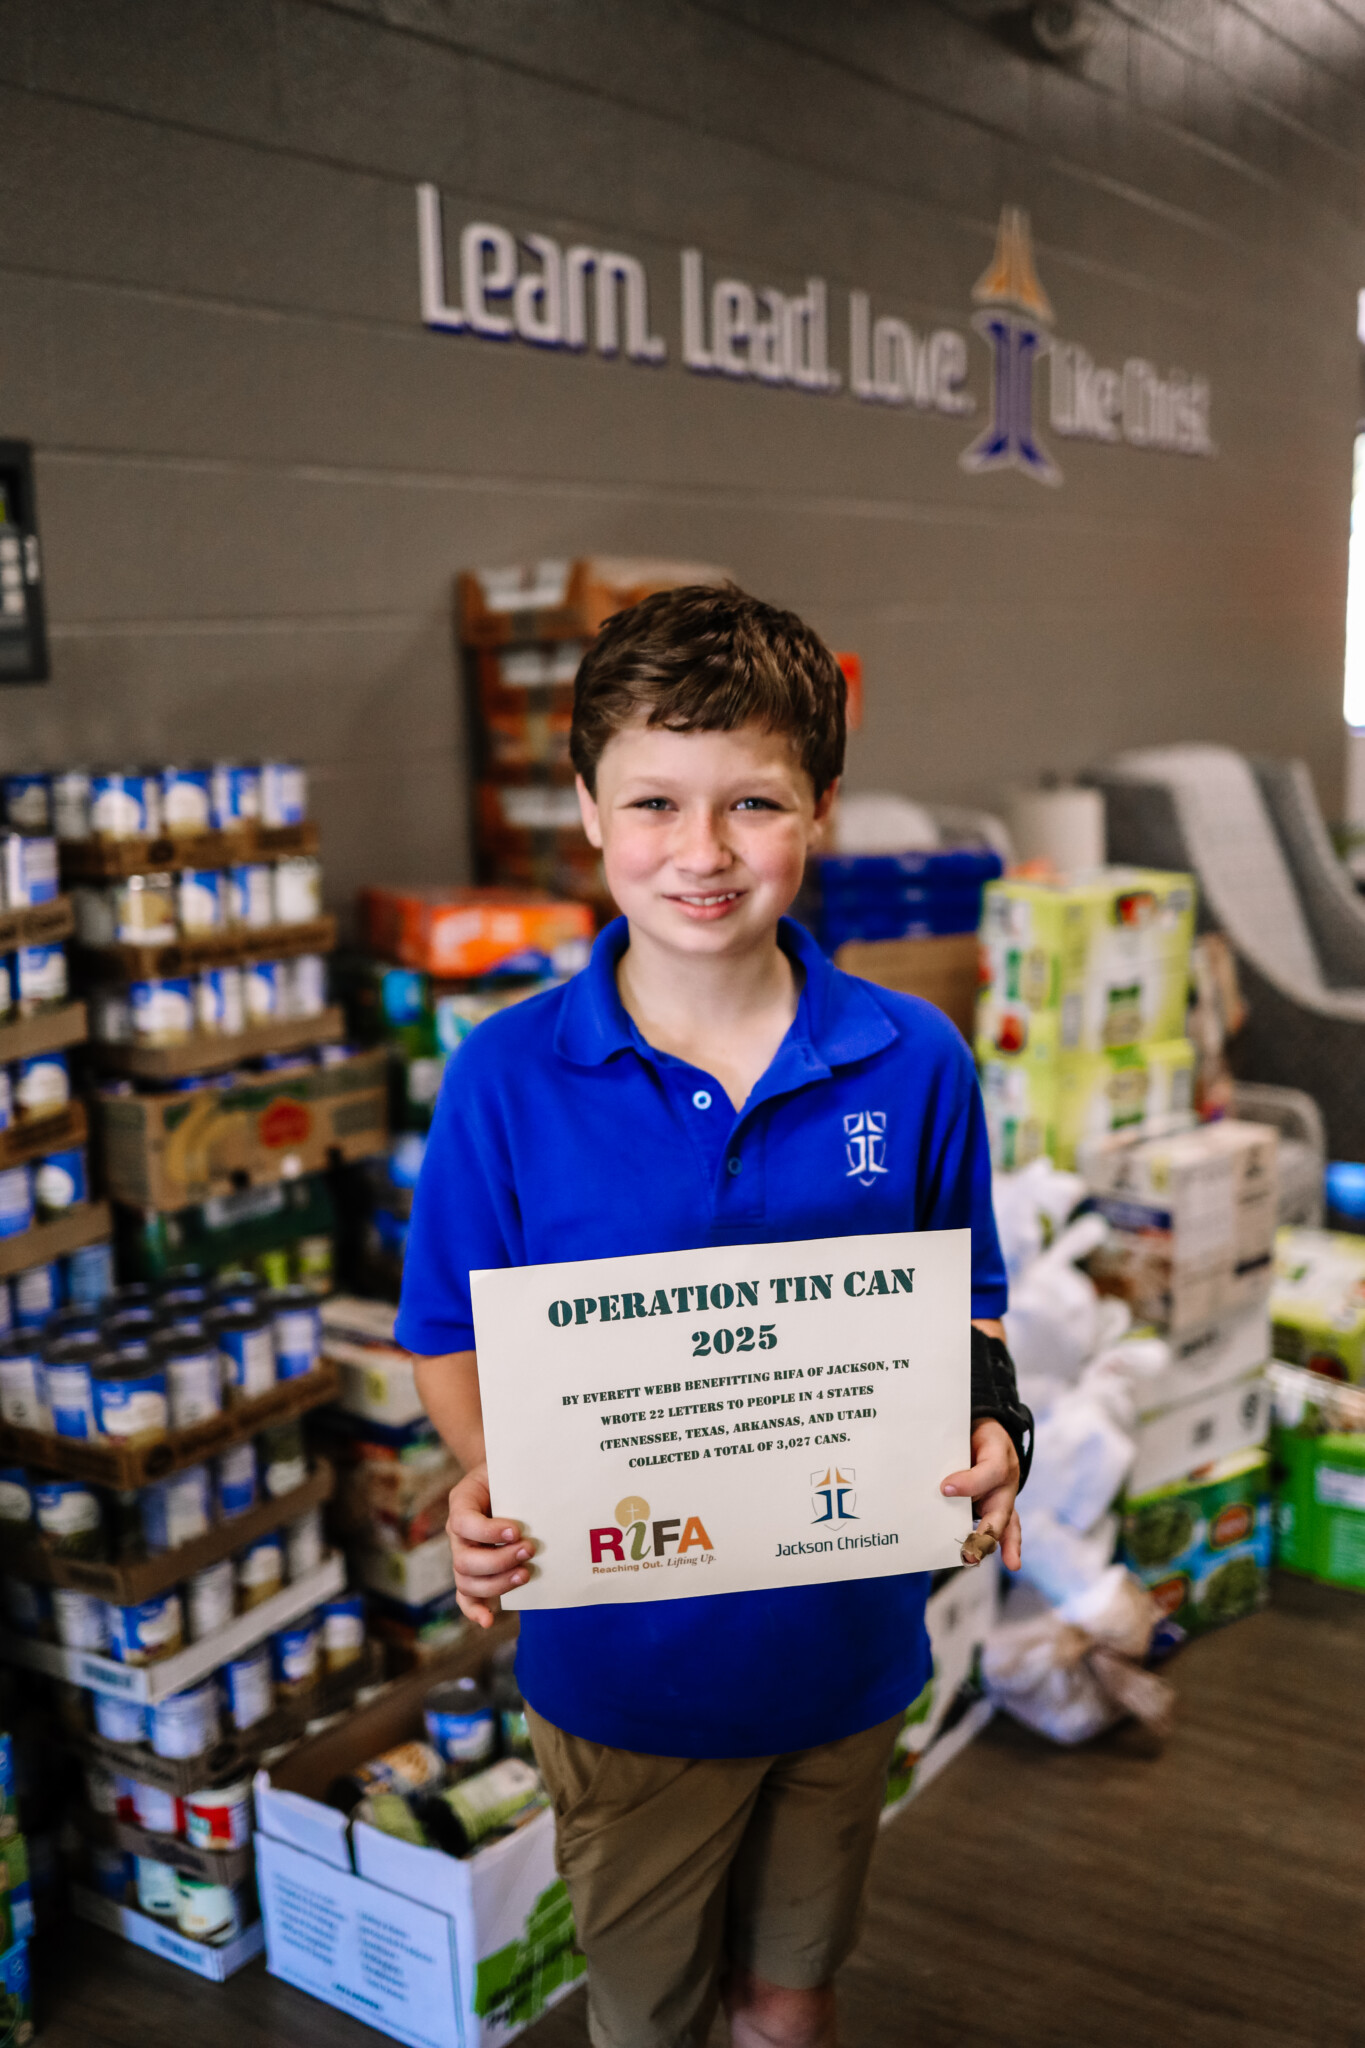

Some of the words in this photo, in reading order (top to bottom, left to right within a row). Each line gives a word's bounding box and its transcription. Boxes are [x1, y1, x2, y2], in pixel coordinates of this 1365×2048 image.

[416, 182, 667, 367] Learn.
[680, 247, 842, 389] Lead.
[849, 289, 977, 416] Love.
[547, 1279, 760, 1328] OPERATION
[769, 1273, 834, 1304] TIN
[843, 1267, 916, 1298] CAN
[691, 1323, 778, 1358] 2025
[561, 1394, 580, 1406] BY
[582, 1387, 641, 1404] EVERETT
[643, 1382, 682, 1397] WEBB
[684, 1371, 770, 1392] BENEFITTING
[773, 1368, 805, 1381] RIFA
[806, 1366, 824, 1377] OF
[826, 1360, 889, 1376] JACKSON,
[892, 1358, 910, 1370] TN
[600, 1410, 647, 1426] WROTE
[649, 1408, 665, 1420] 22
[668, 1401, 725, 1418] LETTERS
[726, 1398, 744, 1410] TO
[746, 1392, 796, 1408] PEOPLE
[798, 1390, 813, 1402] IN
[815, 1389, 824, 1400] 4
[826, 1384, 874, 1399] STATES
[599, 1430, 683, 1452] (TENNESSEE,
[684, 1424, 730, 1439] TEXAS,
[732, 1415, 806, 1434] ARKANSAS,
[808, 1412, 835, 1425] AND
[836, 1407, 877, 1421] UTAH)
[628, 1450, 700, 1469] COLLECTED
[702, 1448, 712, 1459] A
[713, 1443, 755, 1457] TOTAL
[756, 1440, 774, 1452] OF
[776, 1436, 811, 1451] 3,027
[814, 1432, 851, 1446] CANS.
[592, 1562, 640, 1574] Reaching
[642, 1560, 663, 1570] Out.
[666, 1555, 698, 1568] Lifting
[700, 1553, 717, 1564] Up.
[775, 1541, 833, 1557] Jackson
[837, 1532, 899, 1550] Christian
